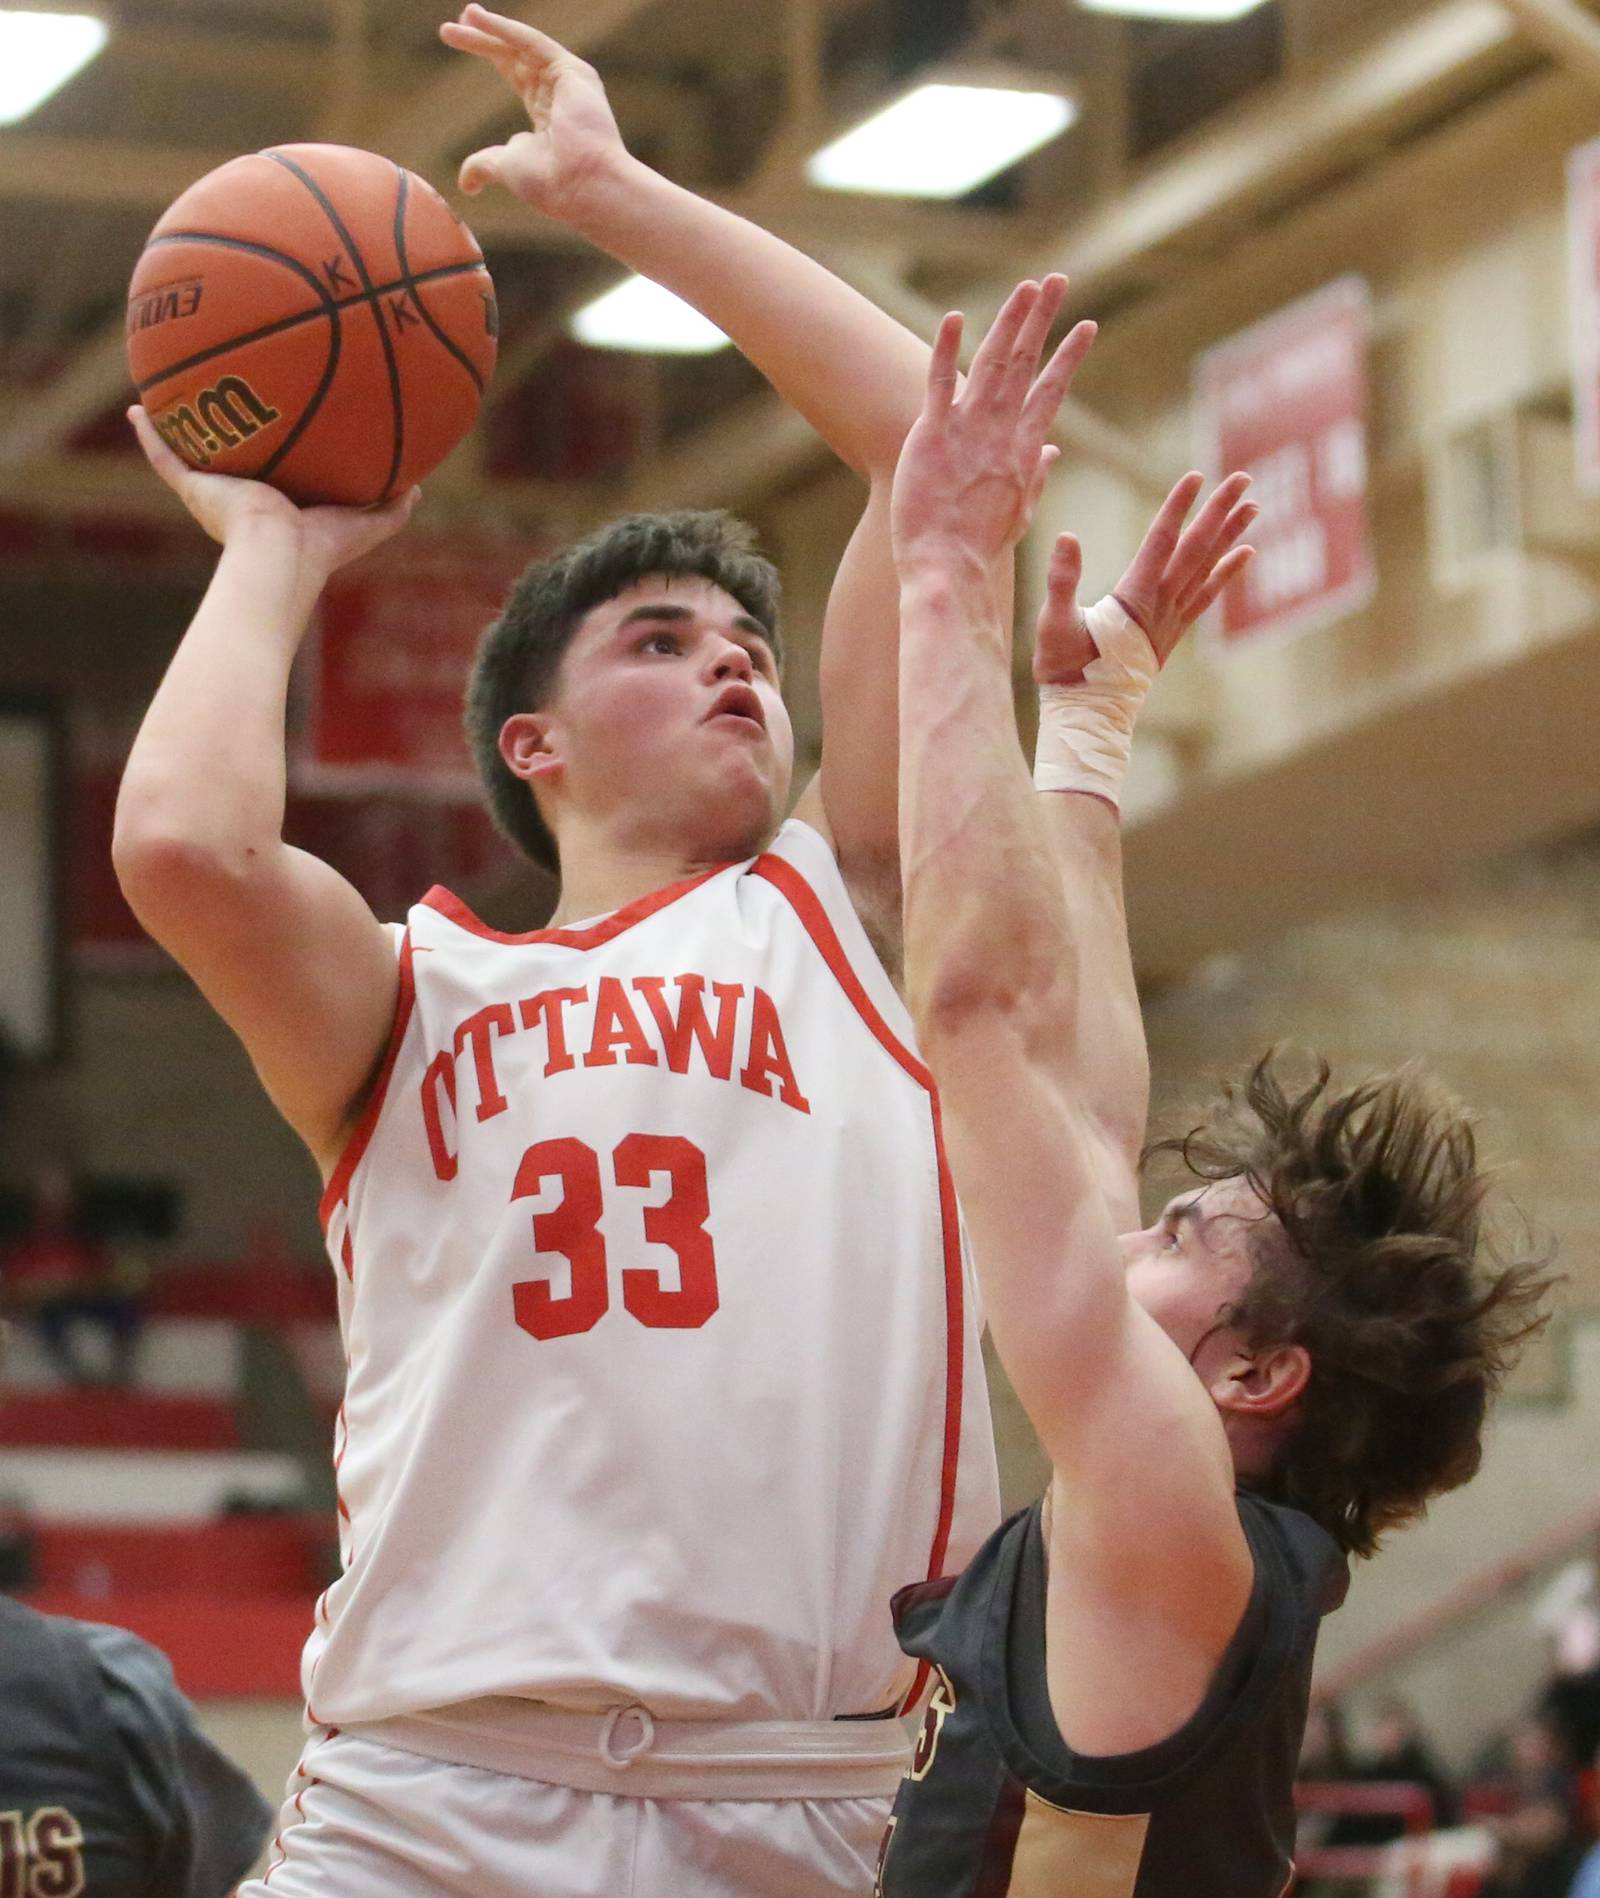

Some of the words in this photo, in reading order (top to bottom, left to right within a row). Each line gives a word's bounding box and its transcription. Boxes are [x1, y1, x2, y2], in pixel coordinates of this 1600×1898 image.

[322, 255, 357, 293] K
[387, 293, 420, 334] K
[421, 973, 811, 1181] OTTAWA
[510, 1132, 719, 1340] 33
